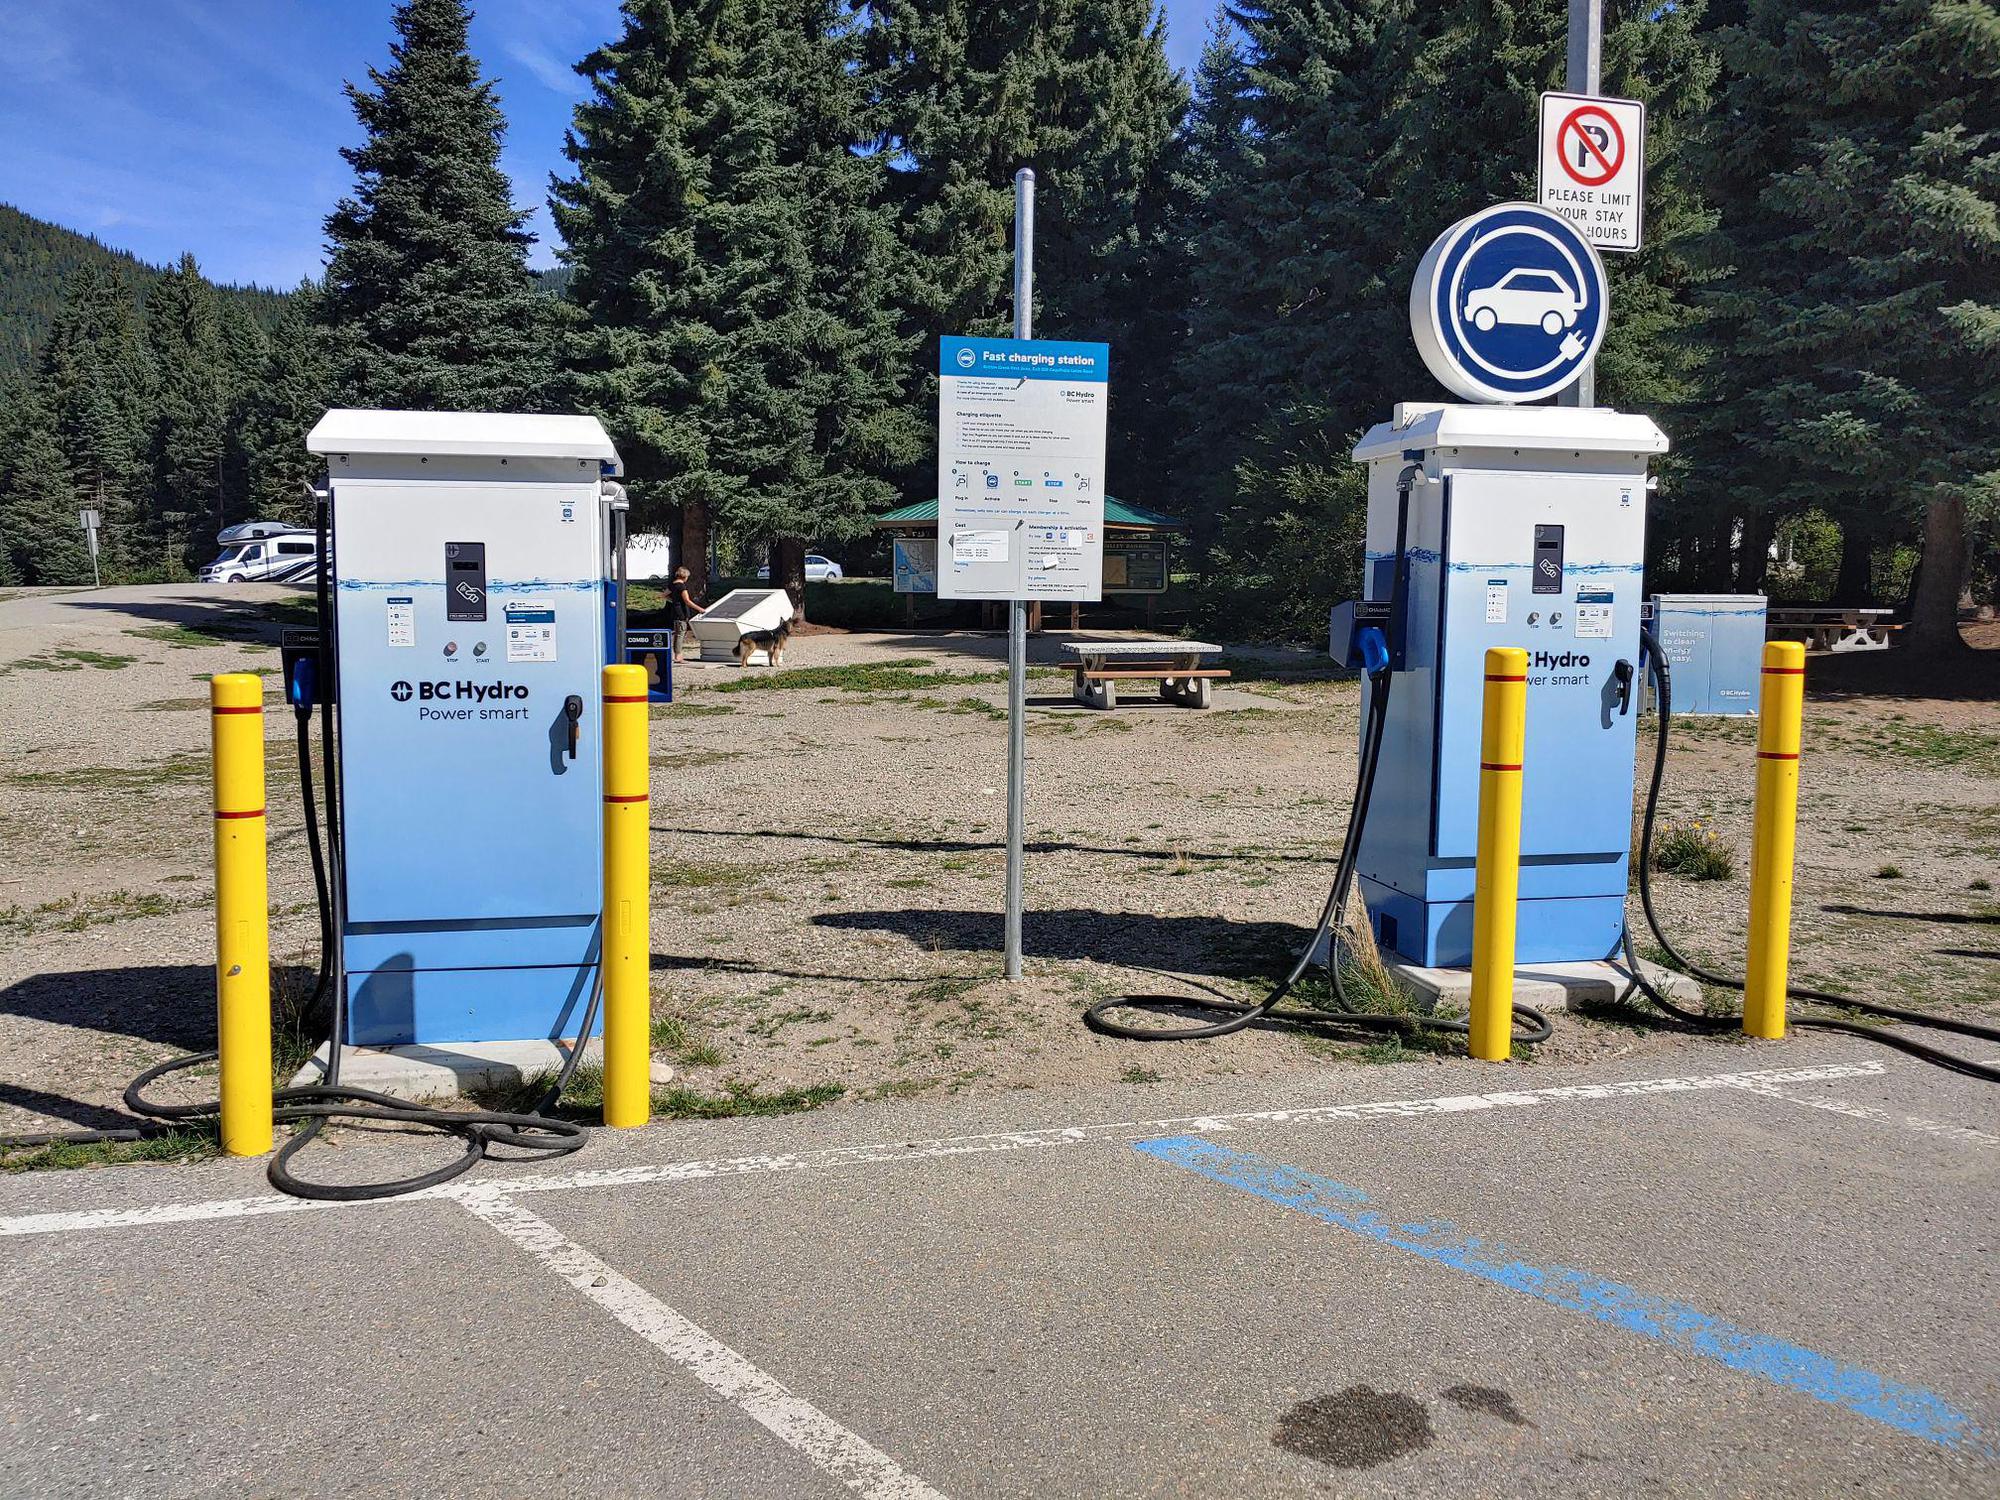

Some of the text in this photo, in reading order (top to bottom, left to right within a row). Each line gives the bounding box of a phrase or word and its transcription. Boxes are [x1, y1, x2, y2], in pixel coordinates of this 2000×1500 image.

[1548, 188, 1632, 206] PLEASE LIMIT
[1596, 210, 1624, 222] STAY
[983, 351, 1095, 366] Fast charging station
[1664, 629, 1704, 638] Switching
[1535, 651, 1590, 671] Hydro
[1526, 674, 1589, 685] wer smart
[420, 681, 529, 703] BC Hydro
[420, 707, 529, 720] Power smart
